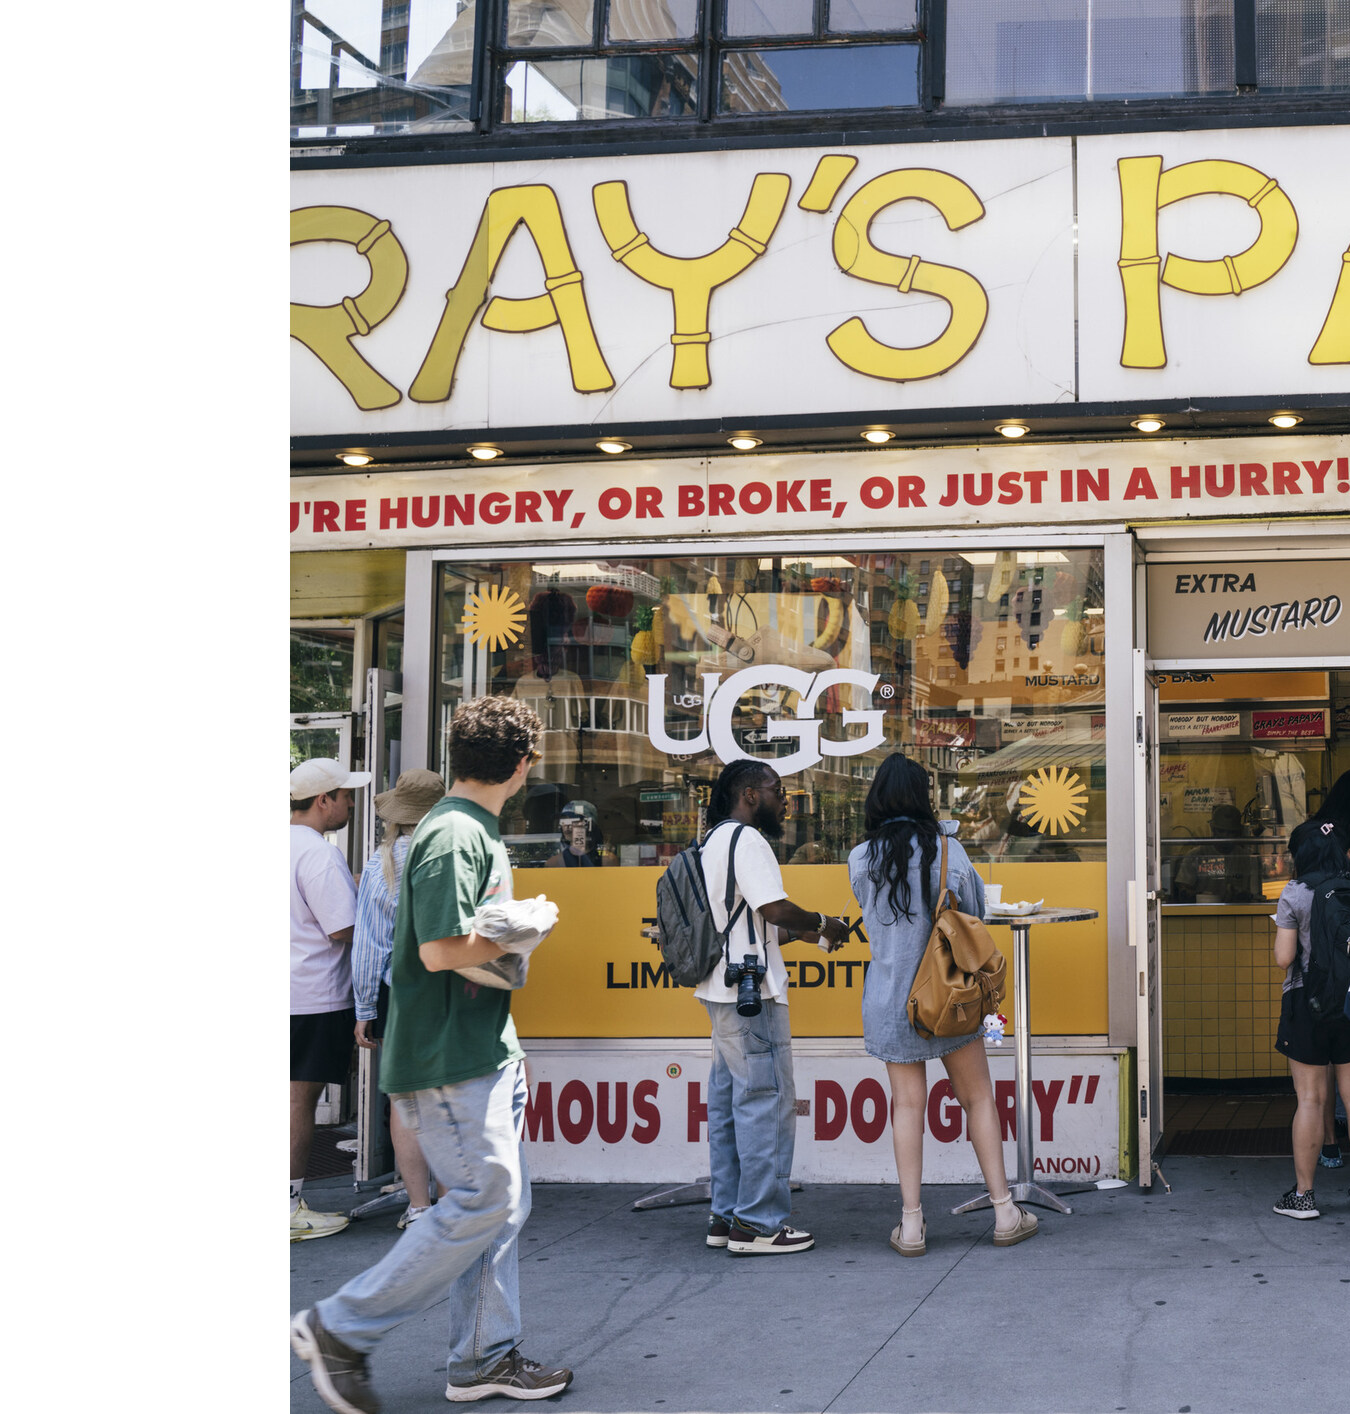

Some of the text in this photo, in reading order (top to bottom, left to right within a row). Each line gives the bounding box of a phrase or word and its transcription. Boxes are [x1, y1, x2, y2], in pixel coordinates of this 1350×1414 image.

[379, 489, 586, 529] HUNGRY,
[599, 486, 664, 520] OR
[678, 479, 848, 518] BROKE,
[860, 475, 928, 509] OR
[939, 470, 1048, 506] JUST
[1061, 468, 1109, 503] IN
[1122, 467, 1159, 500] A
[1170, 457, 1350, 499] HURRY!
[1174, 573, 1257, 594] EXTRA
[1203, 594, 1343, 644] MUSTARD
[1025, 674, 1101, 687] MUSTARD
[673, 694, 702, 708] UGG
[1202, 721, 1239, 735] FRANKFURTER
[1287, 712, 1323, 727] PAPAYA
[1033, 1157, 1101, 1176] ANON)
